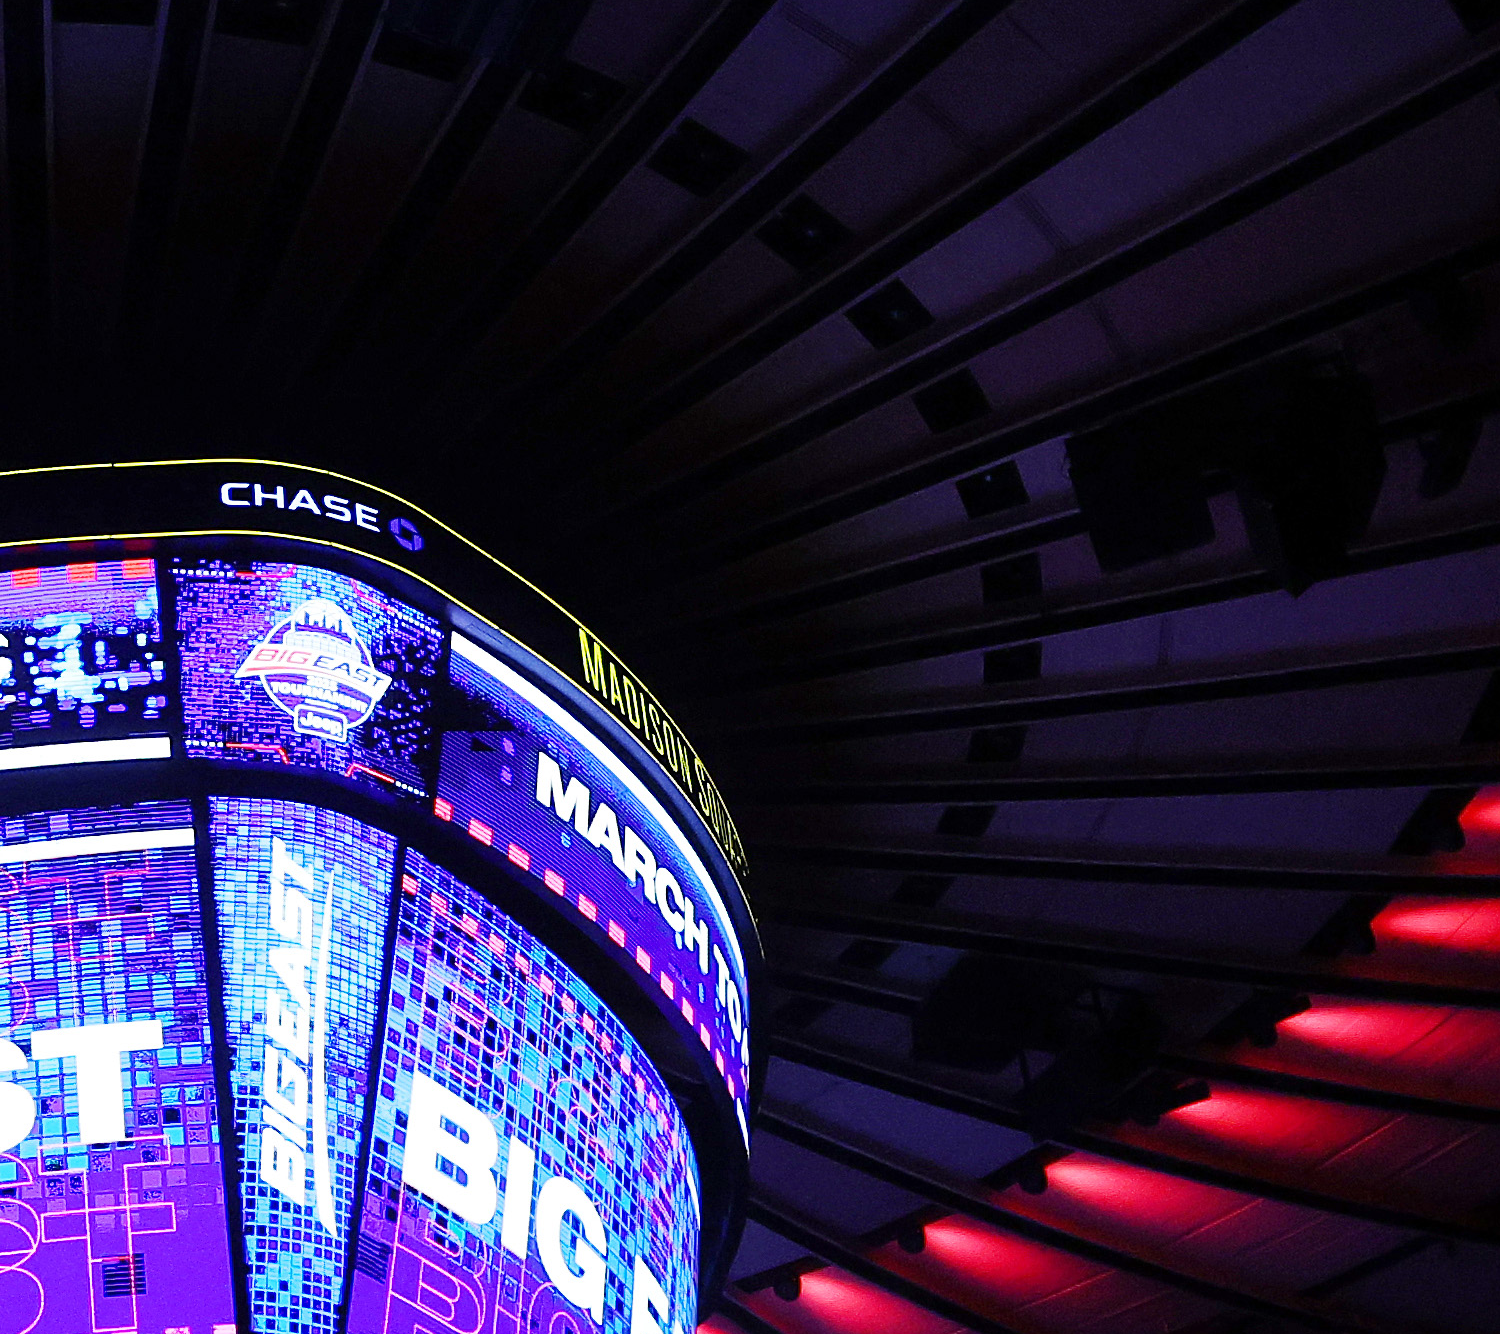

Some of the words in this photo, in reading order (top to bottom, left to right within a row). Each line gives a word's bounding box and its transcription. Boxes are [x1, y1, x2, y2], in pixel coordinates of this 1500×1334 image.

[219, 482, 381, 533] CHASE
[253, 648, 312, 666] BIG
[312, 654, 384, 689] EAST
[270, 681, 368, 714] TOURNAMENT
[578, 627, 694, 795] MADISON
[694, 757, 743, 871] SQUA
[265, 835, 314, 1065] EAST
[536, 750, 710, 976] MARCH
[713, 944, 743, 1042] TO
[260, 1043, 309, 1208] BIG
[401, 1071, 608, 1327] BIG
